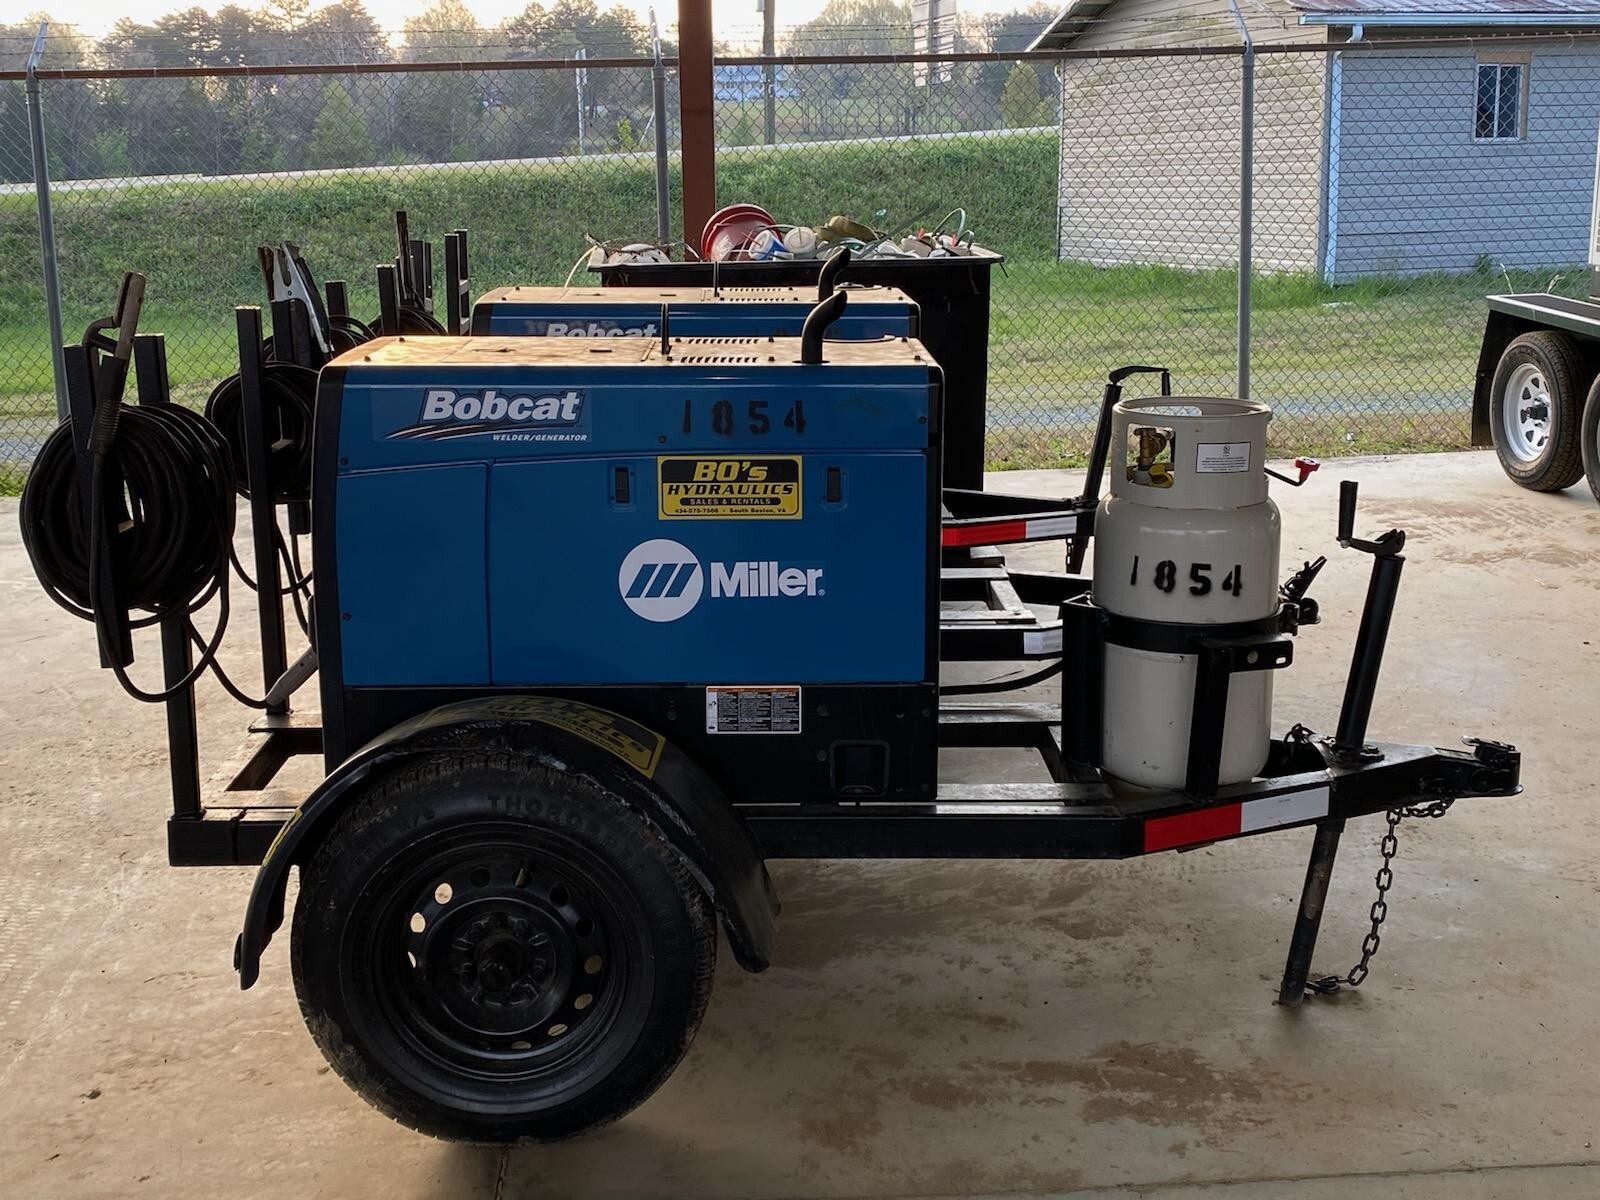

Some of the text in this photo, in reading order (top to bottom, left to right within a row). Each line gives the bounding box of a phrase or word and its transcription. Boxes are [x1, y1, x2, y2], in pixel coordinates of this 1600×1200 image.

[422, 390, 580, 421] Bobcat
[682, 399, 807, 435] 1854
[492, 433, 588, 442] WELDER/GENERATOR
[693, 461, 768, 482] BO's
[667, 484, 793, 495] HYDRAULICS
[710, 560, 824, 598] Miller
[1129, 554, 1243, 598] 1854
